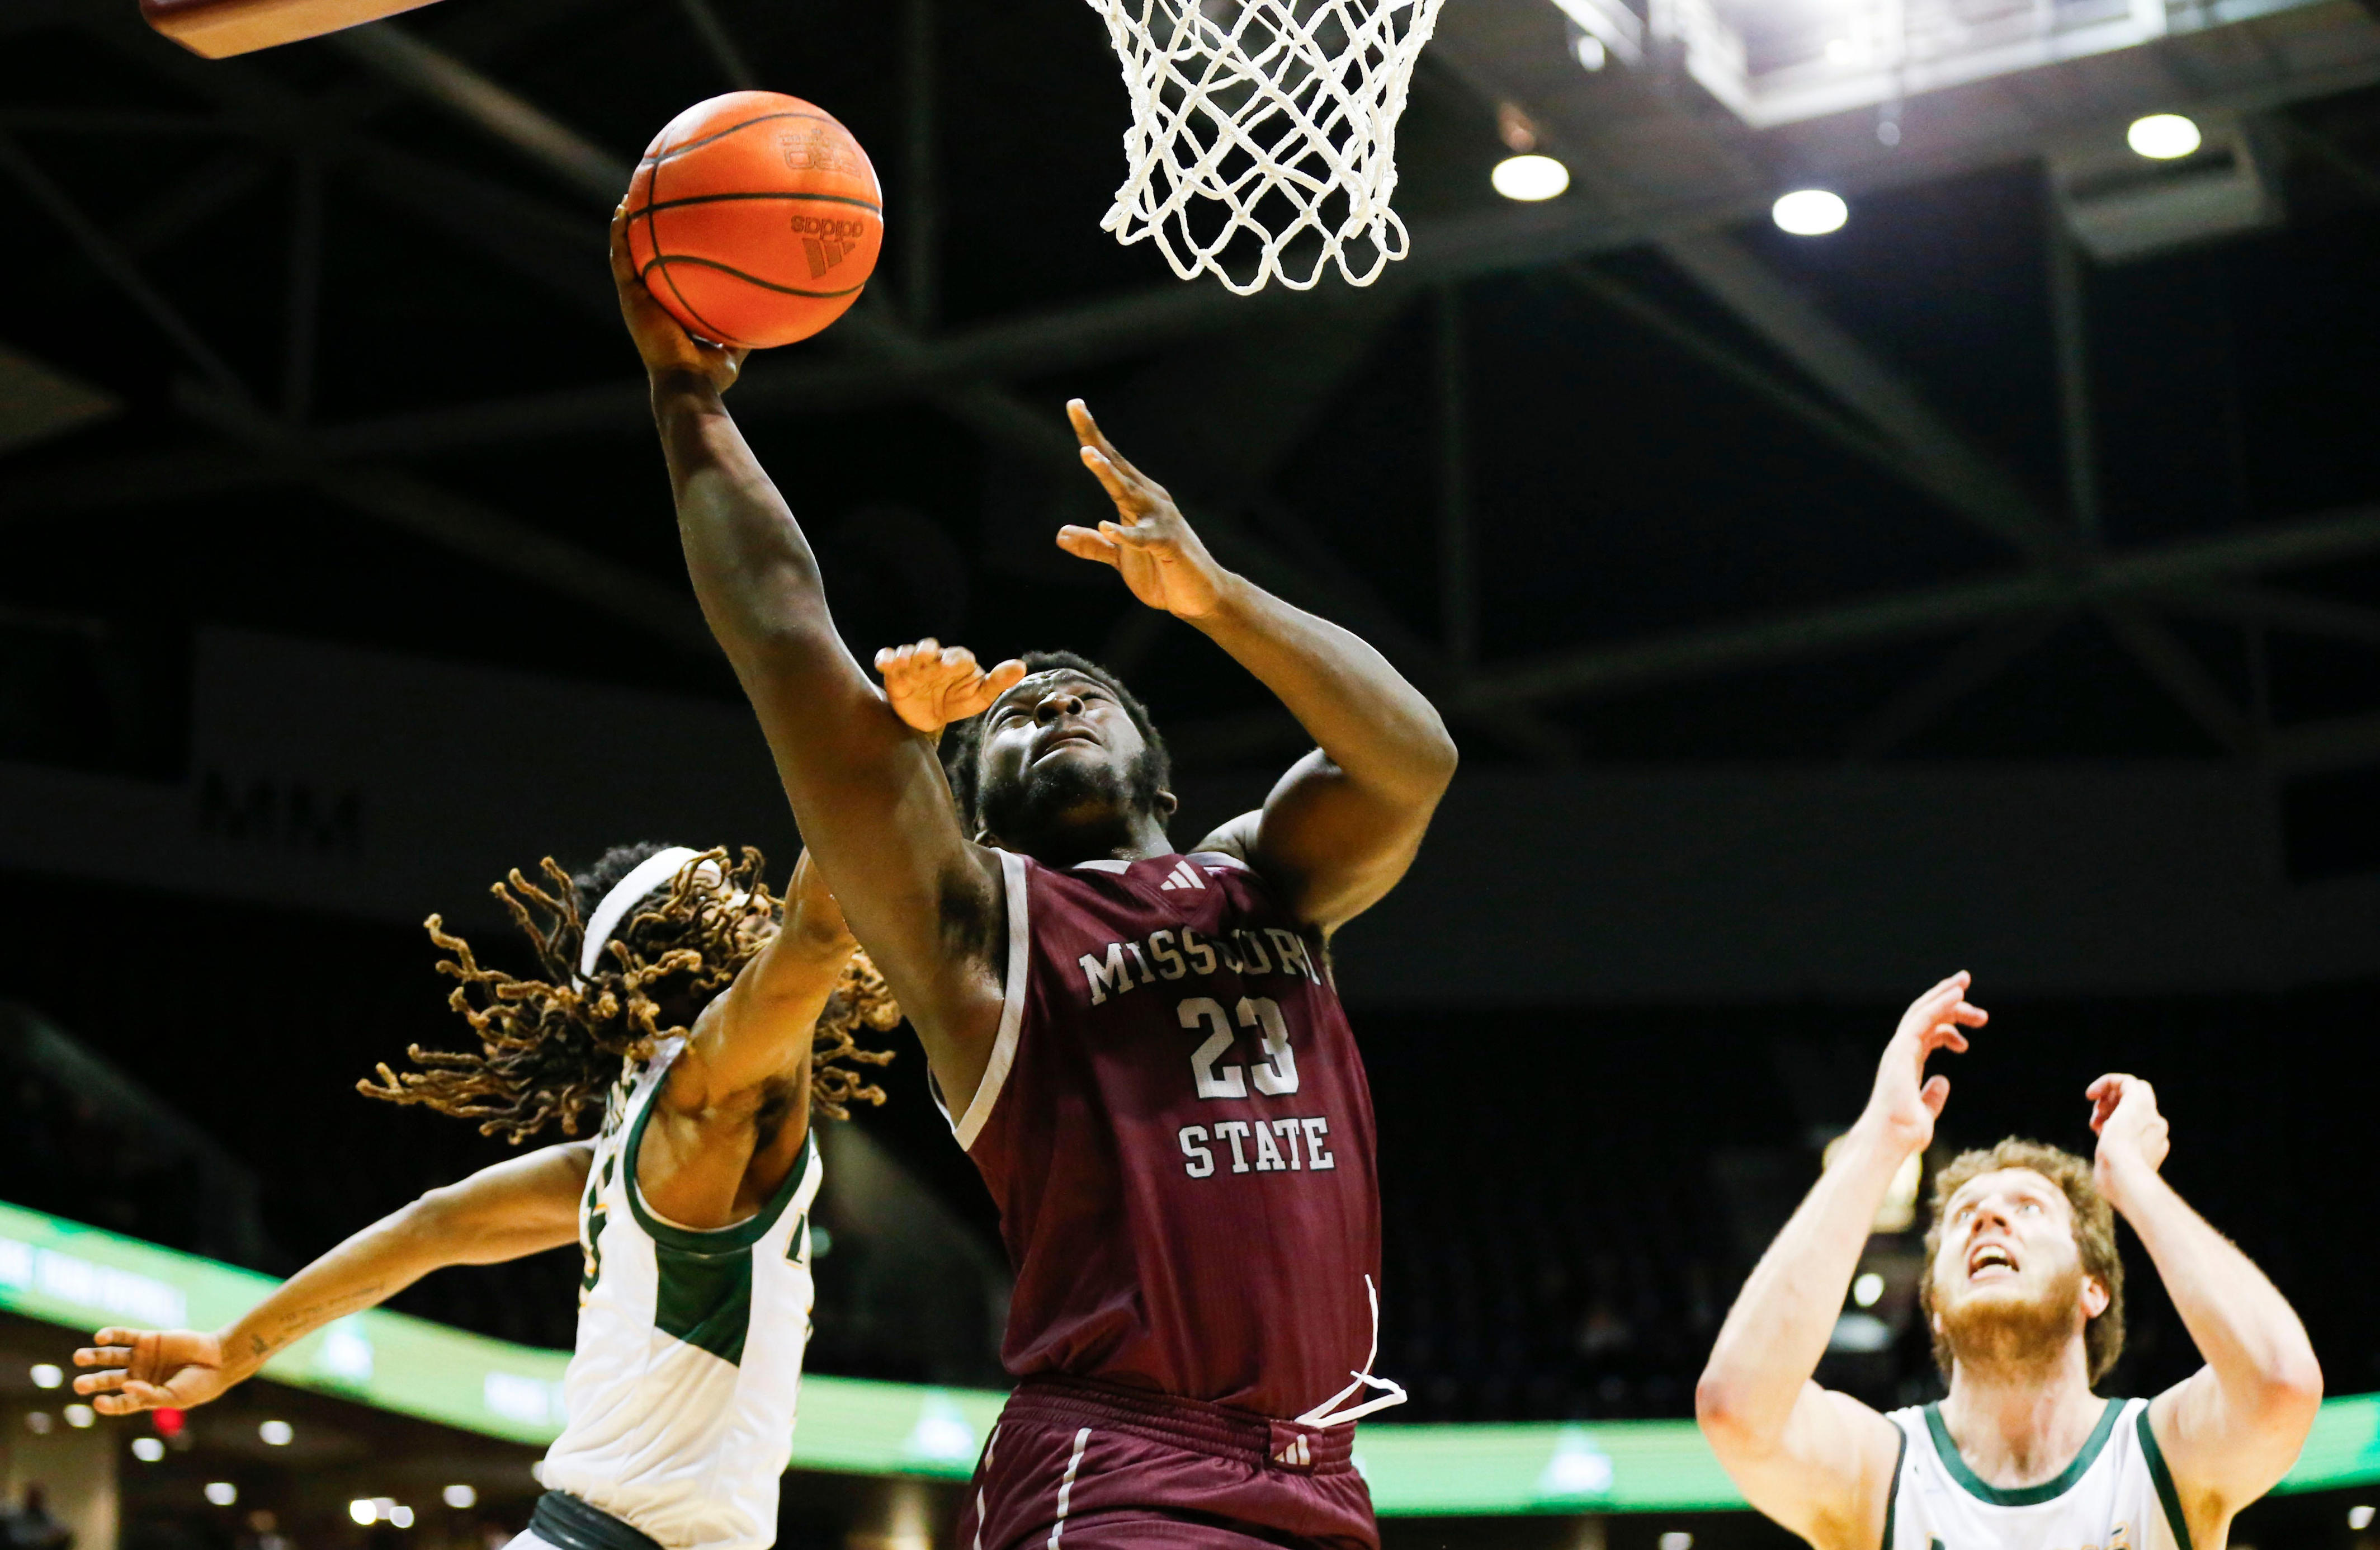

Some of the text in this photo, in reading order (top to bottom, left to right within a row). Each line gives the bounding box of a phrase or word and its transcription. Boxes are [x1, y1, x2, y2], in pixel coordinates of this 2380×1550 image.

[791, 214, 864, 242] adidas
[1177, 996, 1300, 1099] 23
[1178, 1116, 1335, 1179] STATE
